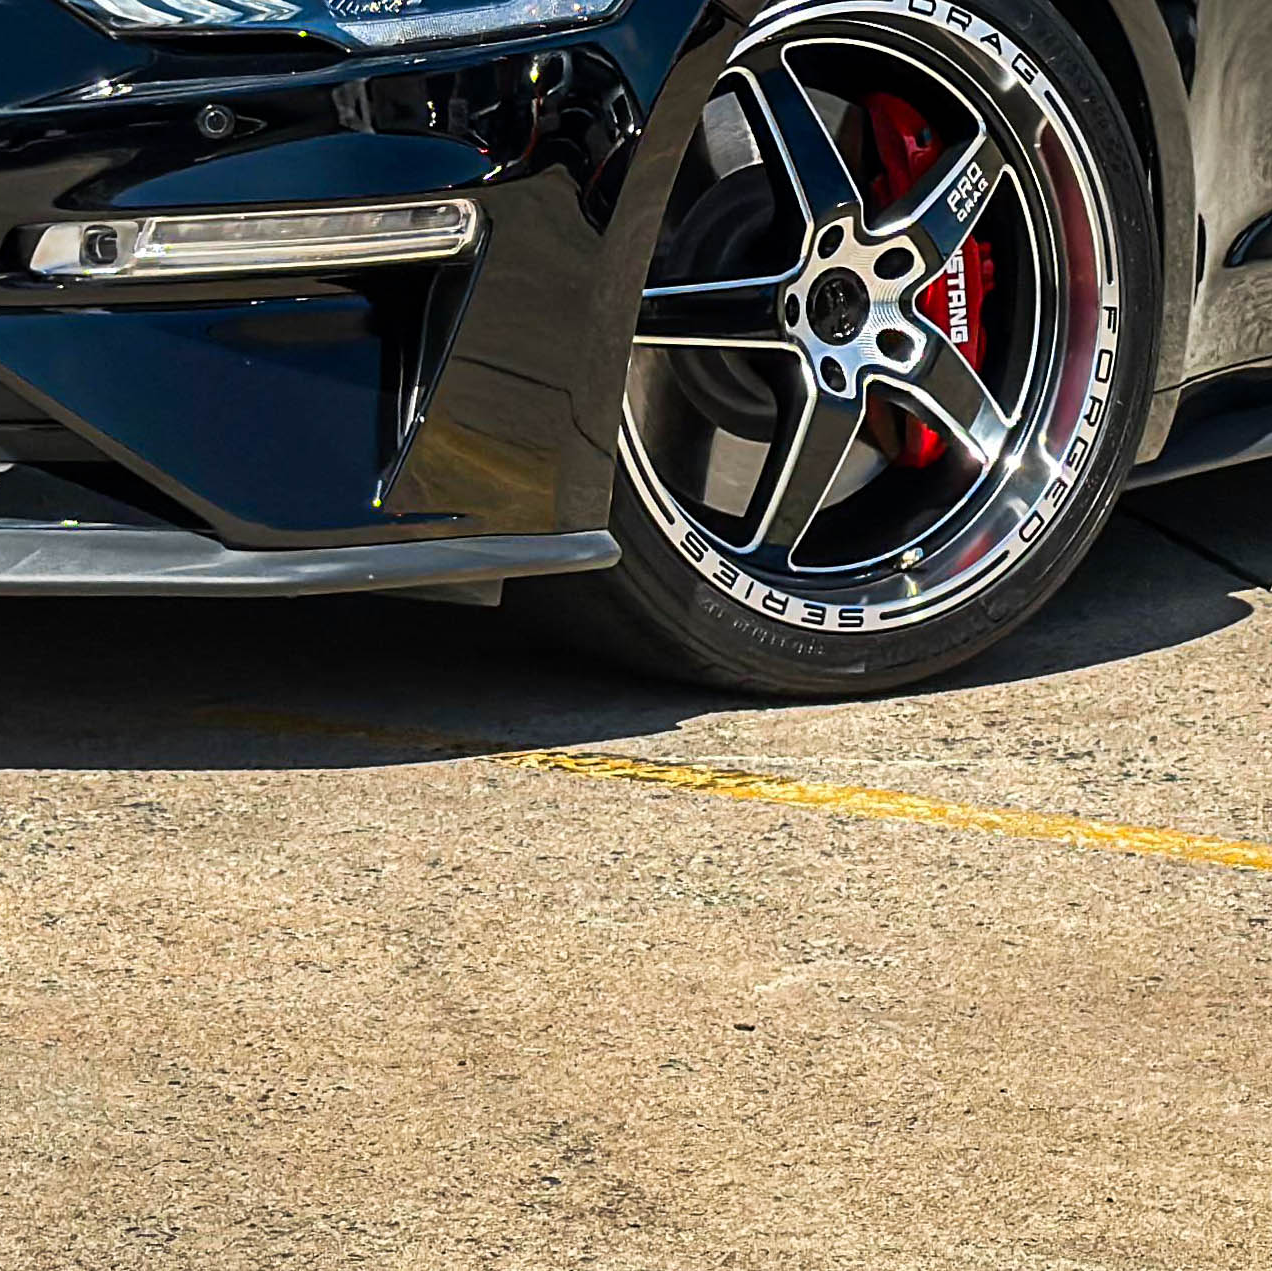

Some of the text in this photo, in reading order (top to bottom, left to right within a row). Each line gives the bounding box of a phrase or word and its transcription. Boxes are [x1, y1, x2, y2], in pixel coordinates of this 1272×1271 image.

[946, 161, 983, 213] PRO
[957, 177, 989, 223] DRAG
[945, 249, 969, 344] STANG
[1018, 306, 1118, 543] FORGED
[680, 531, 865, 628] SERIES
